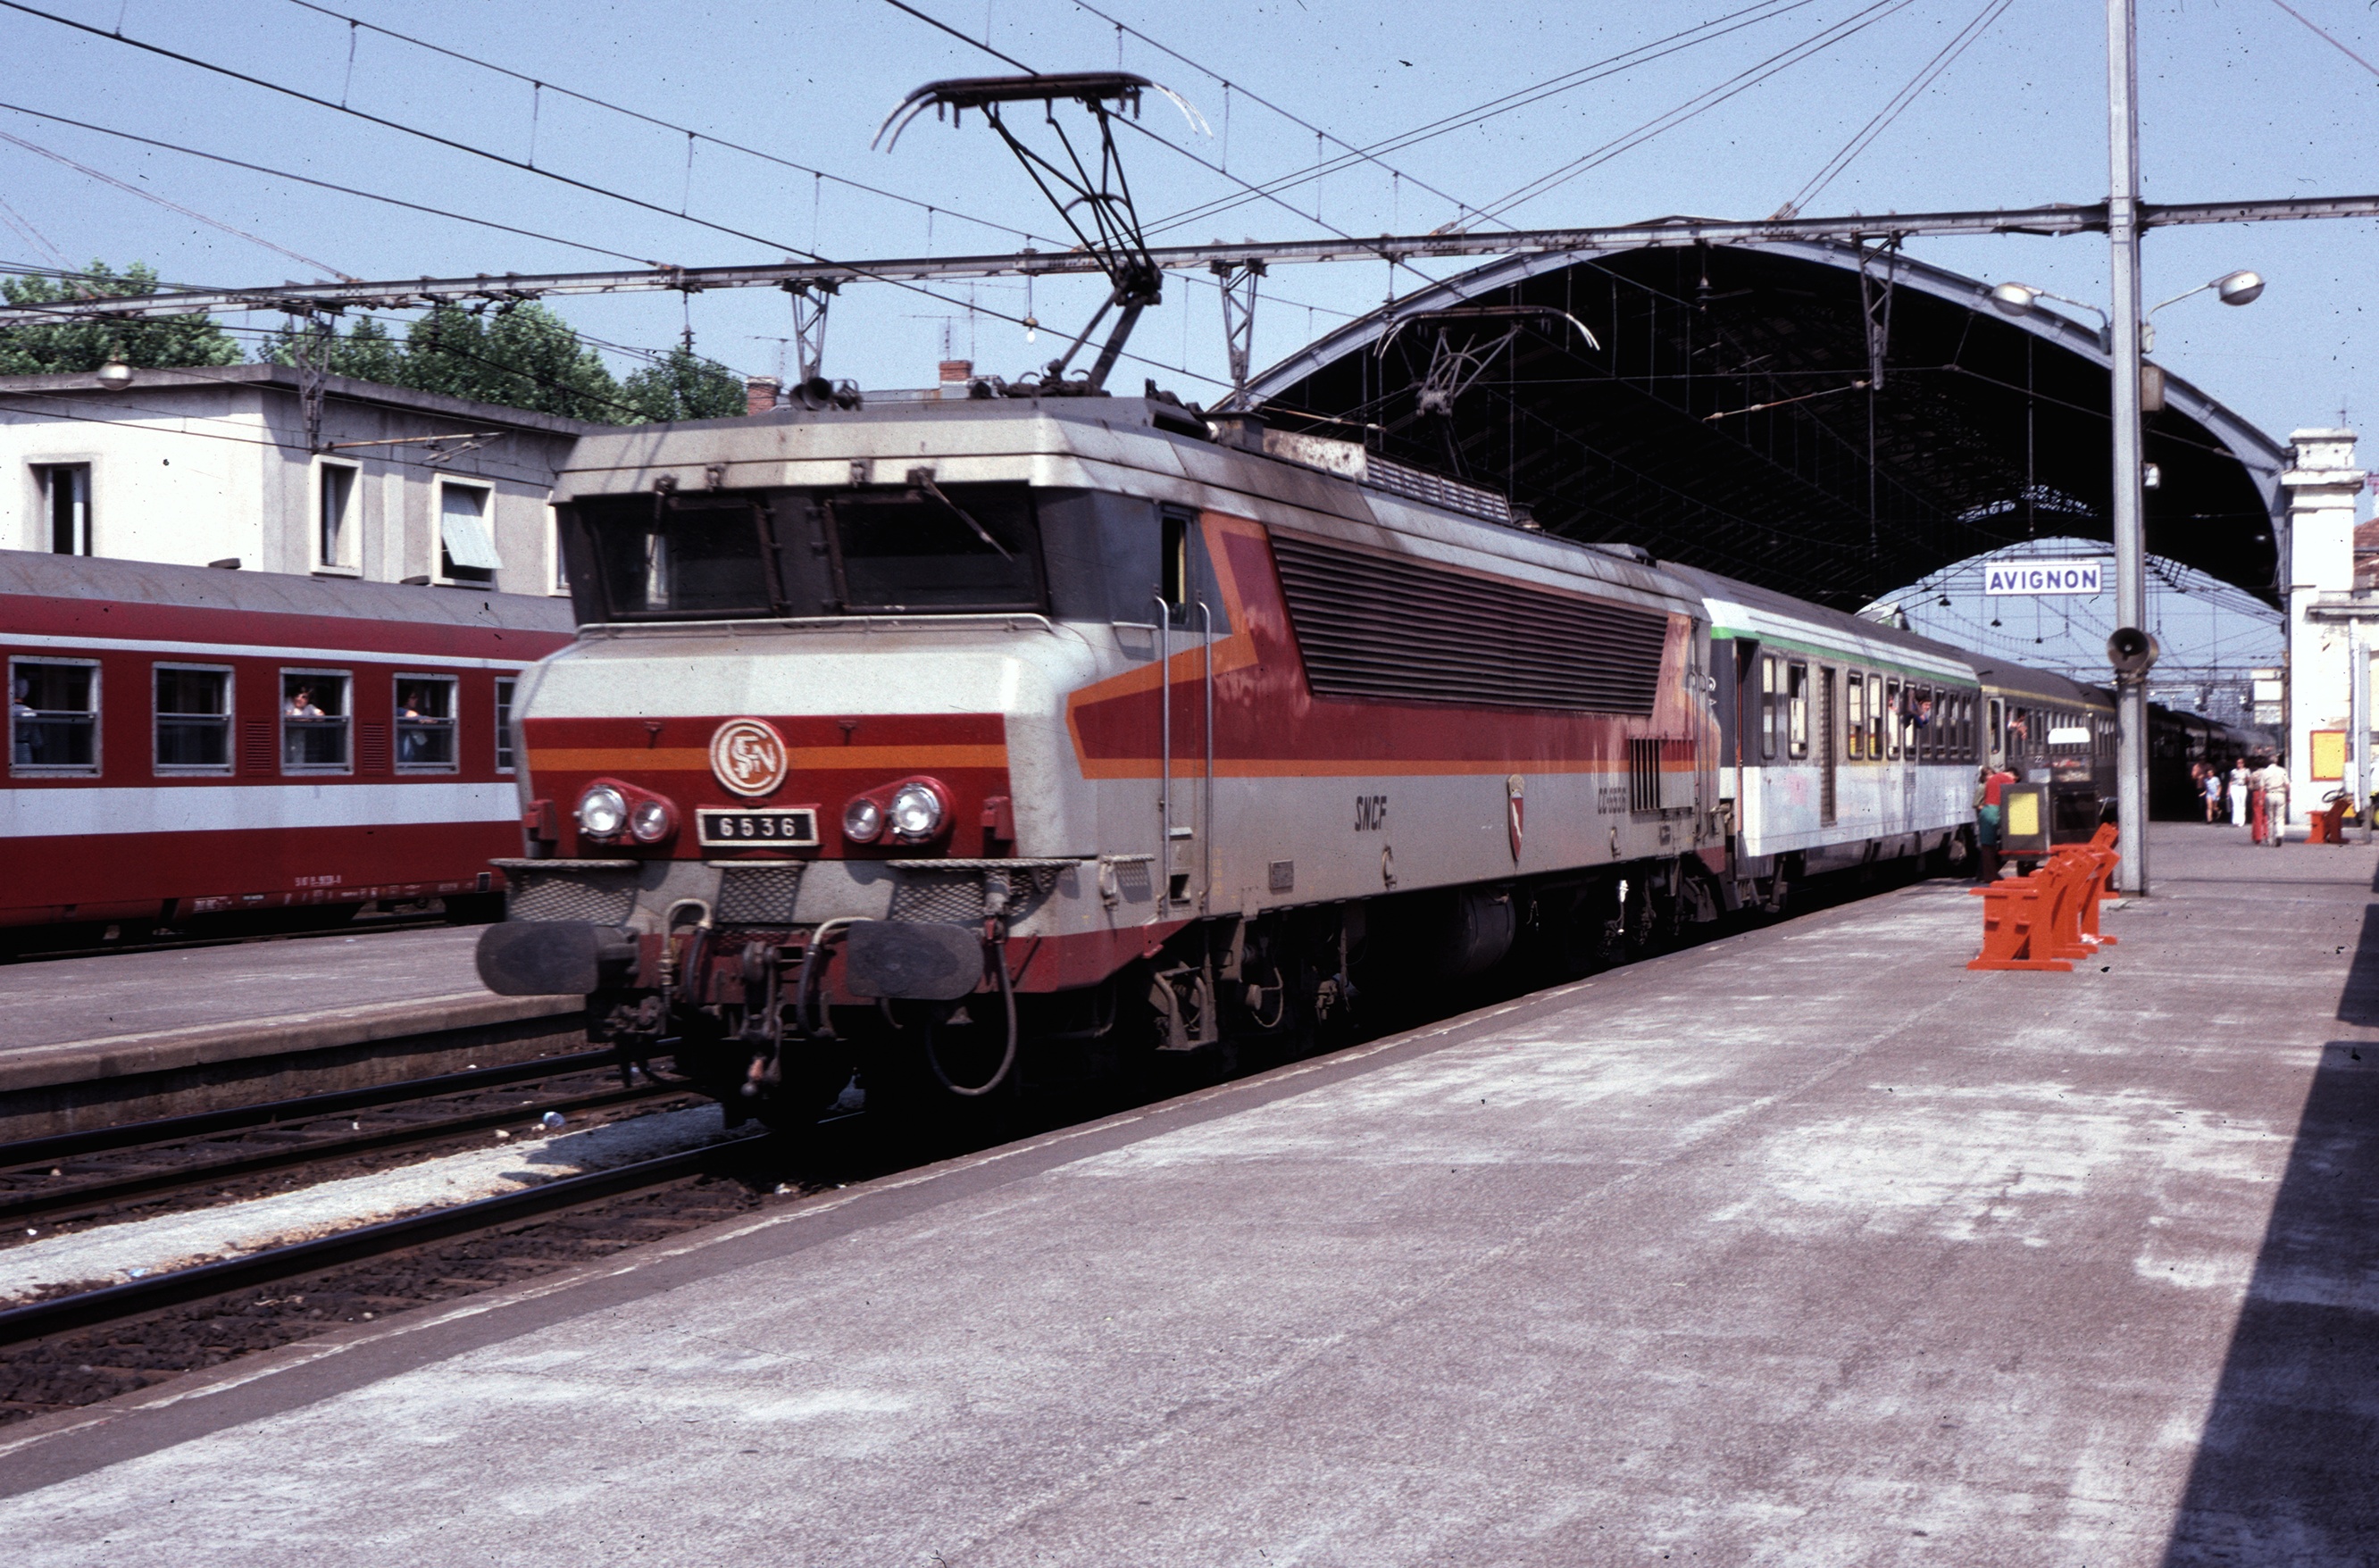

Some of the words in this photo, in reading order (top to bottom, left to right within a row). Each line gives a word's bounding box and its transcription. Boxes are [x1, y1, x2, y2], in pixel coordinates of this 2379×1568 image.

[1990, 570, 2097, 590] AVIGNON
[1355, 795, 1387, 831] SNCF
[719, 817, 796, 837] 6536
